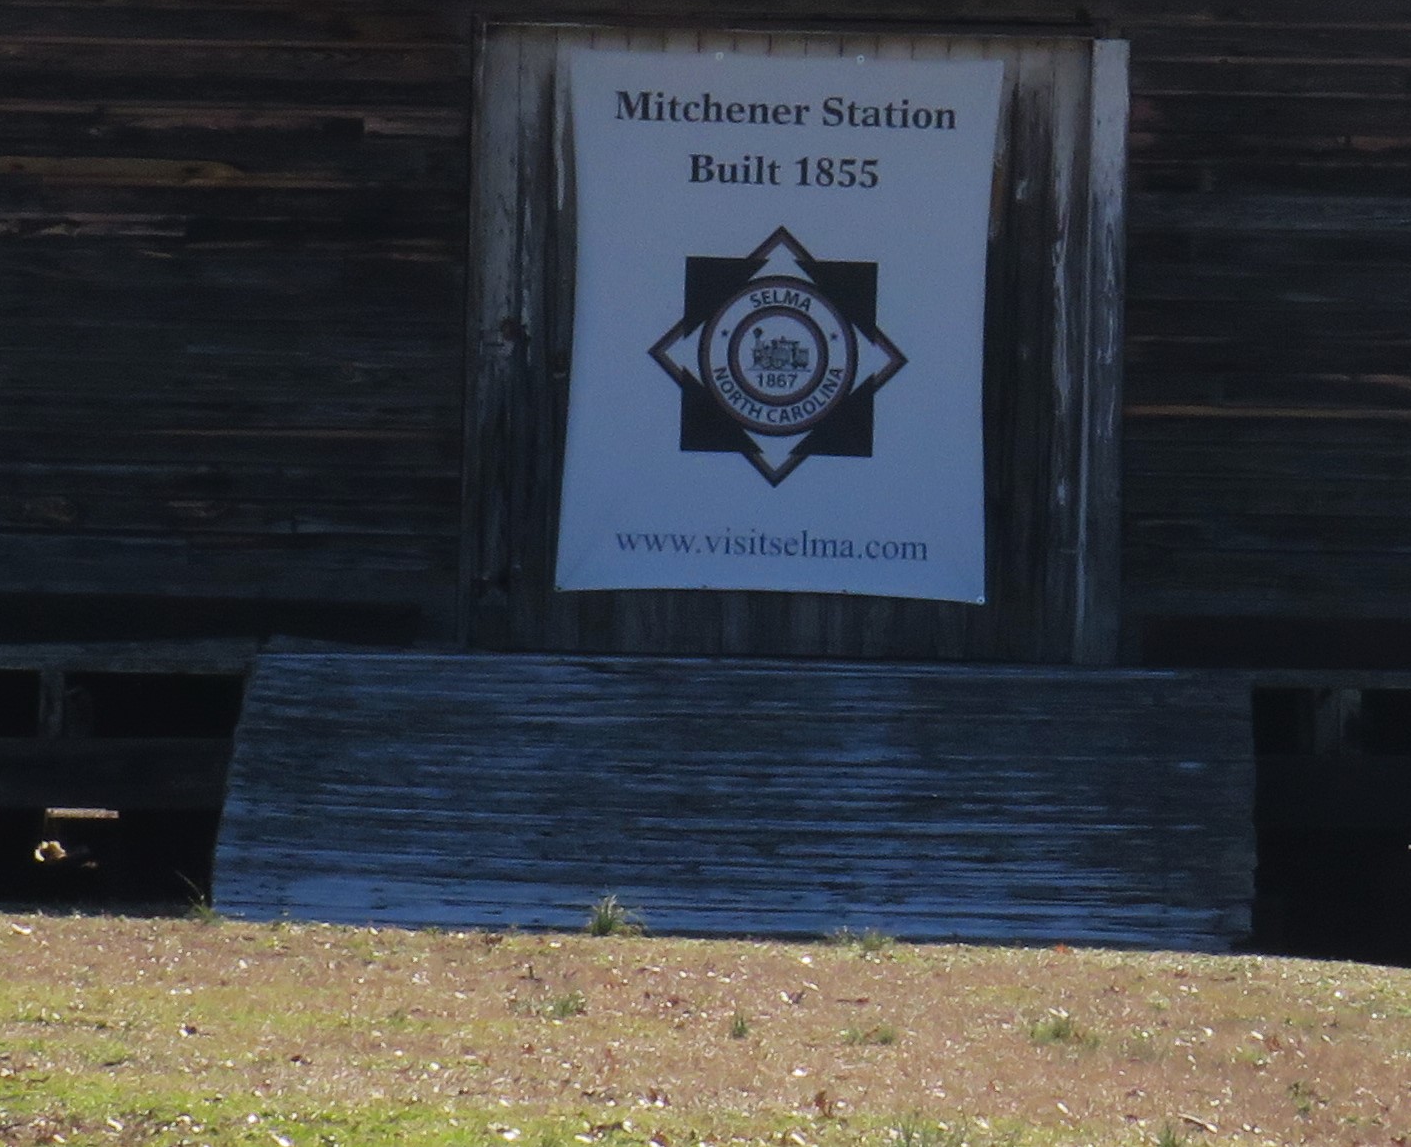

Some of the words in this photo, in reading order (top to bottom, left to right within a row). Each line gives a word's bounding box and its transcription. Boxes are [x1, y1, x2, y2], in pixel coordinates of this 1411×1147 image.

[614, 89, 811, 126] Mitchener
[821, 96, 957, 131] Station
[688, 153, 781, 186] Built
[794, 156, 879, 189] 1855
[749, 288, 812, 312] SELMA
[713, 366, 764, 420] NORTH
[766, 367, 845, 424] CAROLINA
[757, 372, 798, 389] 1867
[615, 526, 929, 562] www.visitselma.com
